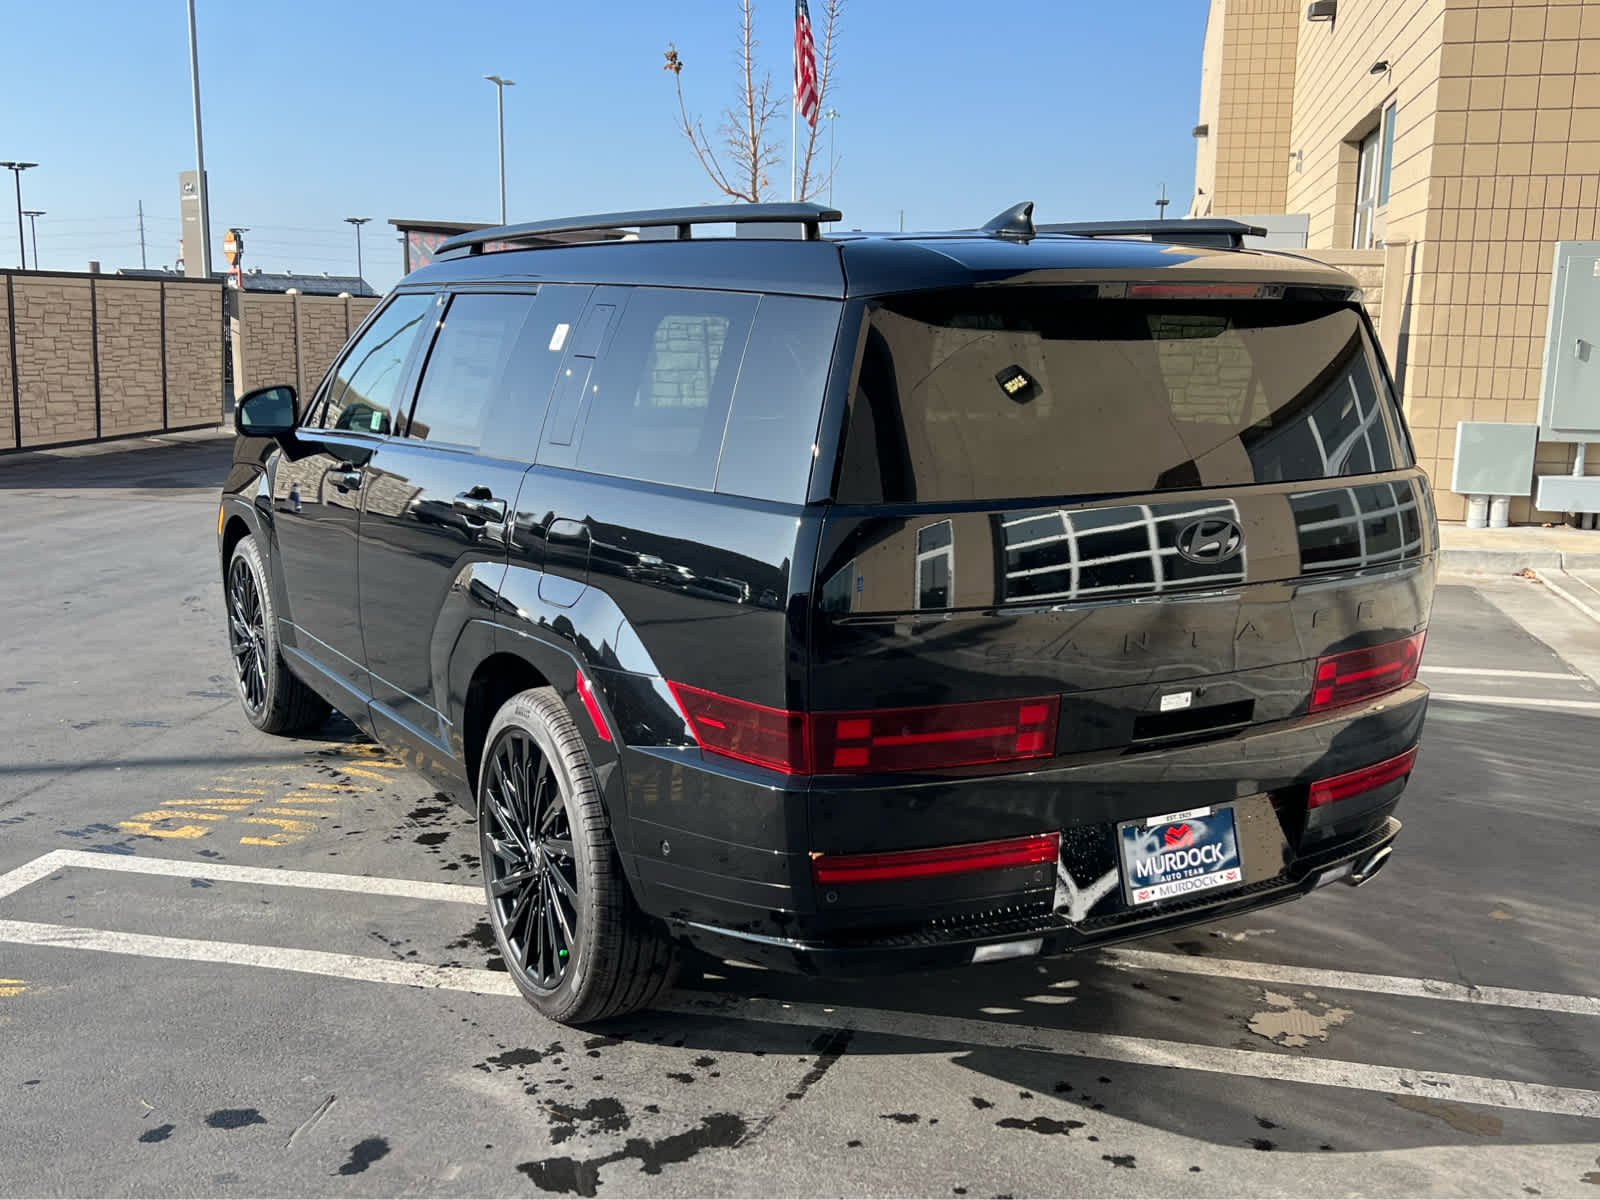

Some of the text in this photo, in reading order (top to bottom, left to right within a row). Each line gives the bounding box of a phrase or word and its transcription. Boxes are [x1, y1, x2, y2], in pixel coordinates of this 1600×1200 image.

[1136, 842, 1225, 878] MURDOCK
[1161, 867, 1204, 882] AUTO TEAM
[1159, 875, 1219, 897] MURDOCK
